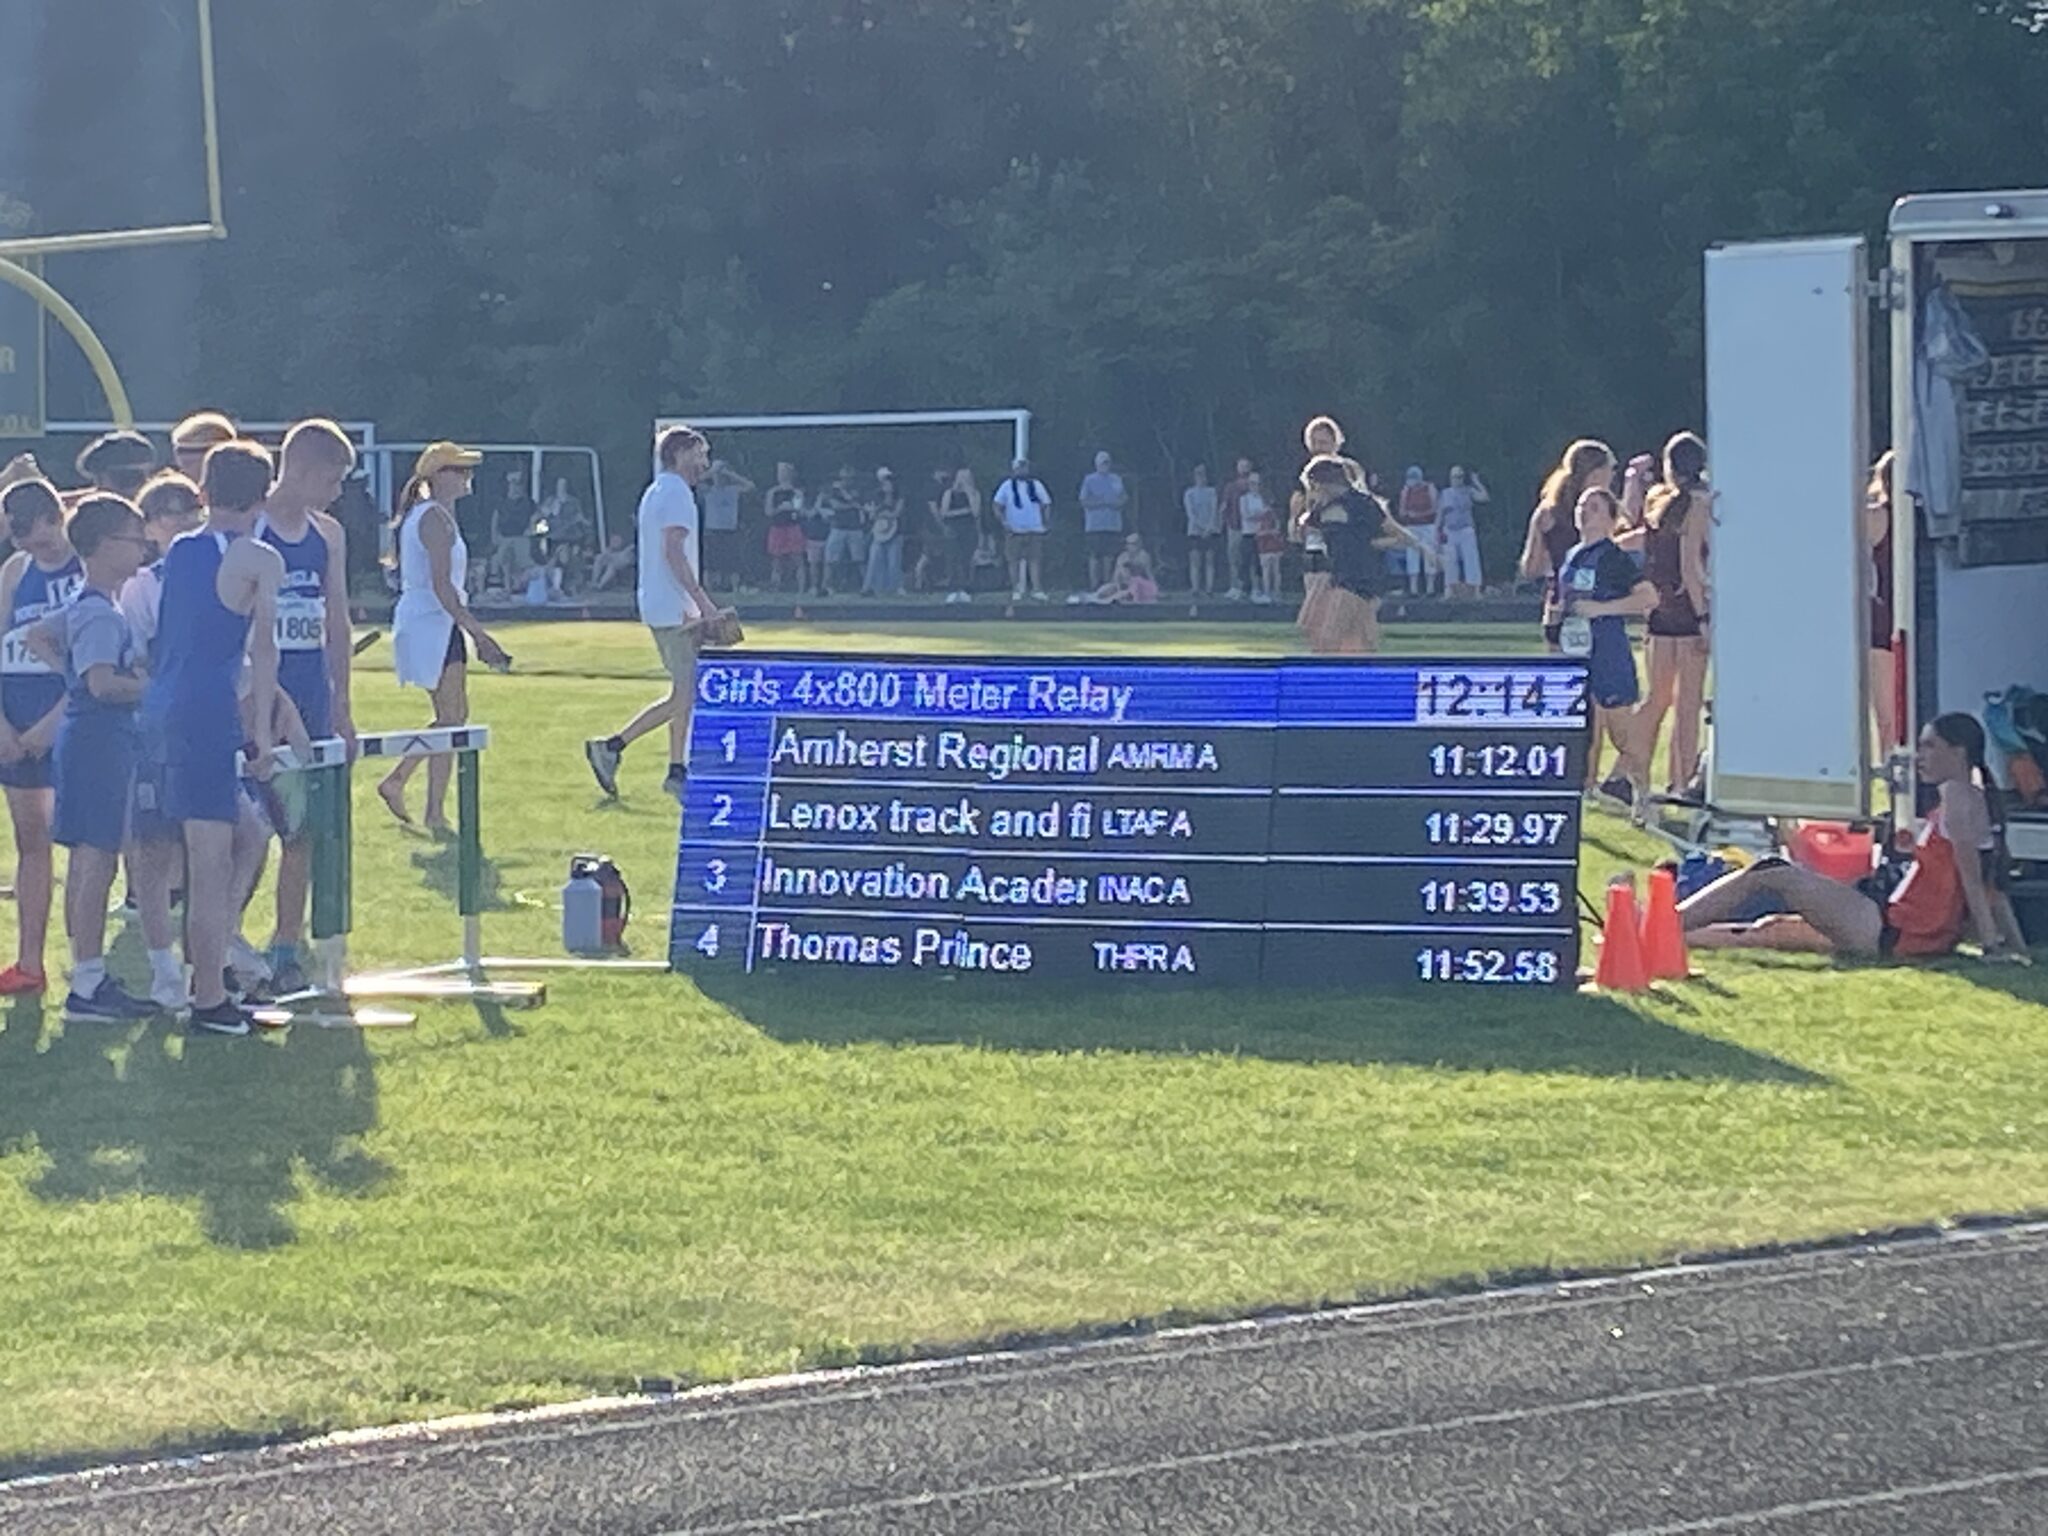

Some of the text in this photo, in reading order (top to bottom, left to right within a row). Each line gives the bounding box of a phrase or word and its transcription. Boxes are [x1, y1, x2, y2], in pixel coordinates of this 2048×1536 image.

[699, 667, 1133, 722] Girls 4x800 Meter Relay
[720, 729, 737, 762] 1
[772, 727, 927, 767] Amherst
[937, 731, 1100, 780] Regional
[1429, 744, 1567, 777] 11:12.01
[709, 793, 733, 827] 2
[769, 792, 881, 831] Lenox
[889, 798, 982, 836] track
[990, 801, 1060, 838] and
[1425, 812, 1568, 845] 11:29.97
[705, 858, 728, 894] 3
[762, 857, 950, 899] Innovation
[1420, 881, 1562, 914] 11:39.53
[696, 924, 719, 956] 4
[757, 922, 901, 965] Thomas
[912, 928, 1033, 971] Prince
[1416, 948, 1559, 983] 11:52.58
